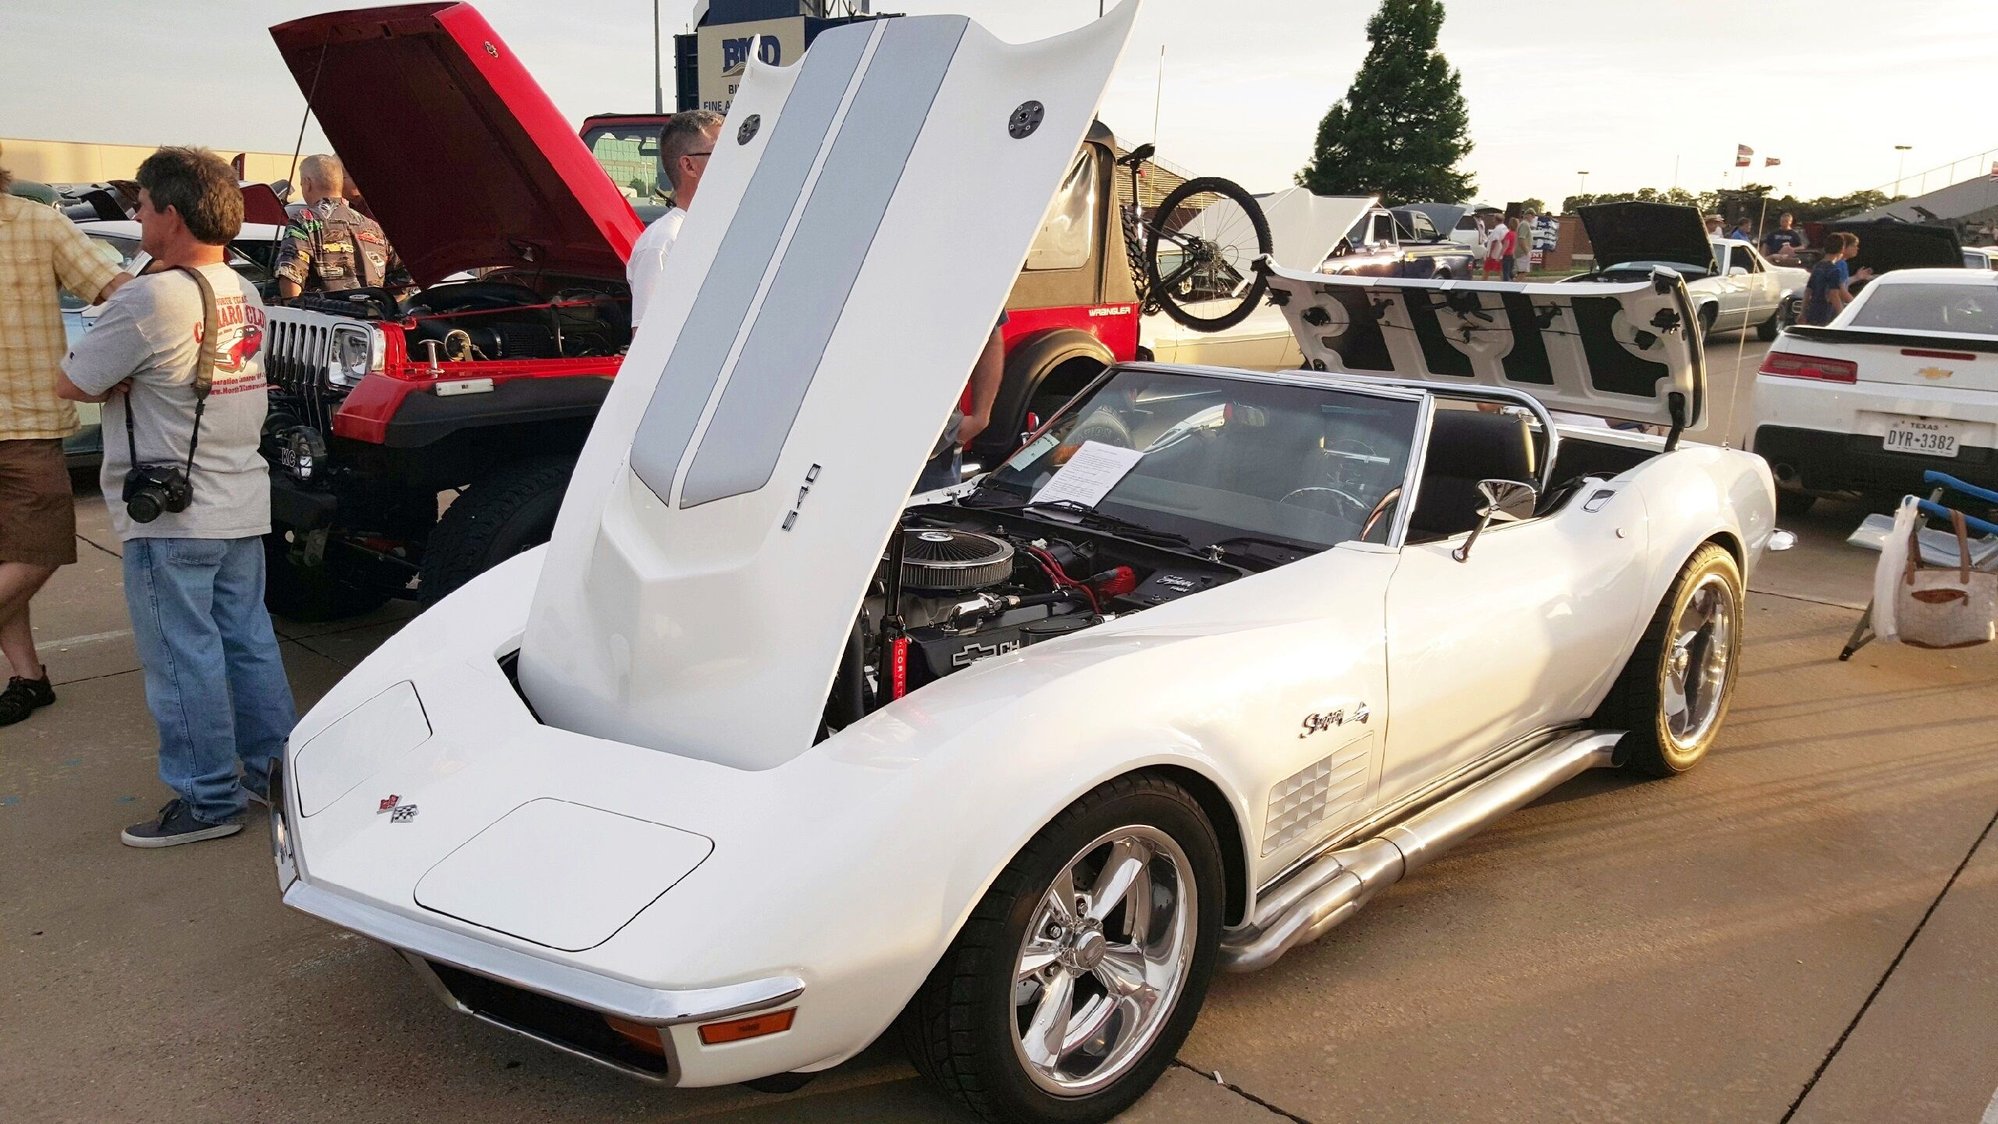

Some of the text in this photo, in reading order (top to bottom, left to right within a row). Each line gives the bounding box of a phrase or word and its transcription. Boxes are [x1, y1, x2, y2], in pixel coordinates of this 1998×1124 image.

[1088, 306, 1131, 317] WRANGLER
[193, 304, 244, 344] CARO
[1911, 422, 1939, 430] TEXAS
[281, 447, 296, 467] KC
